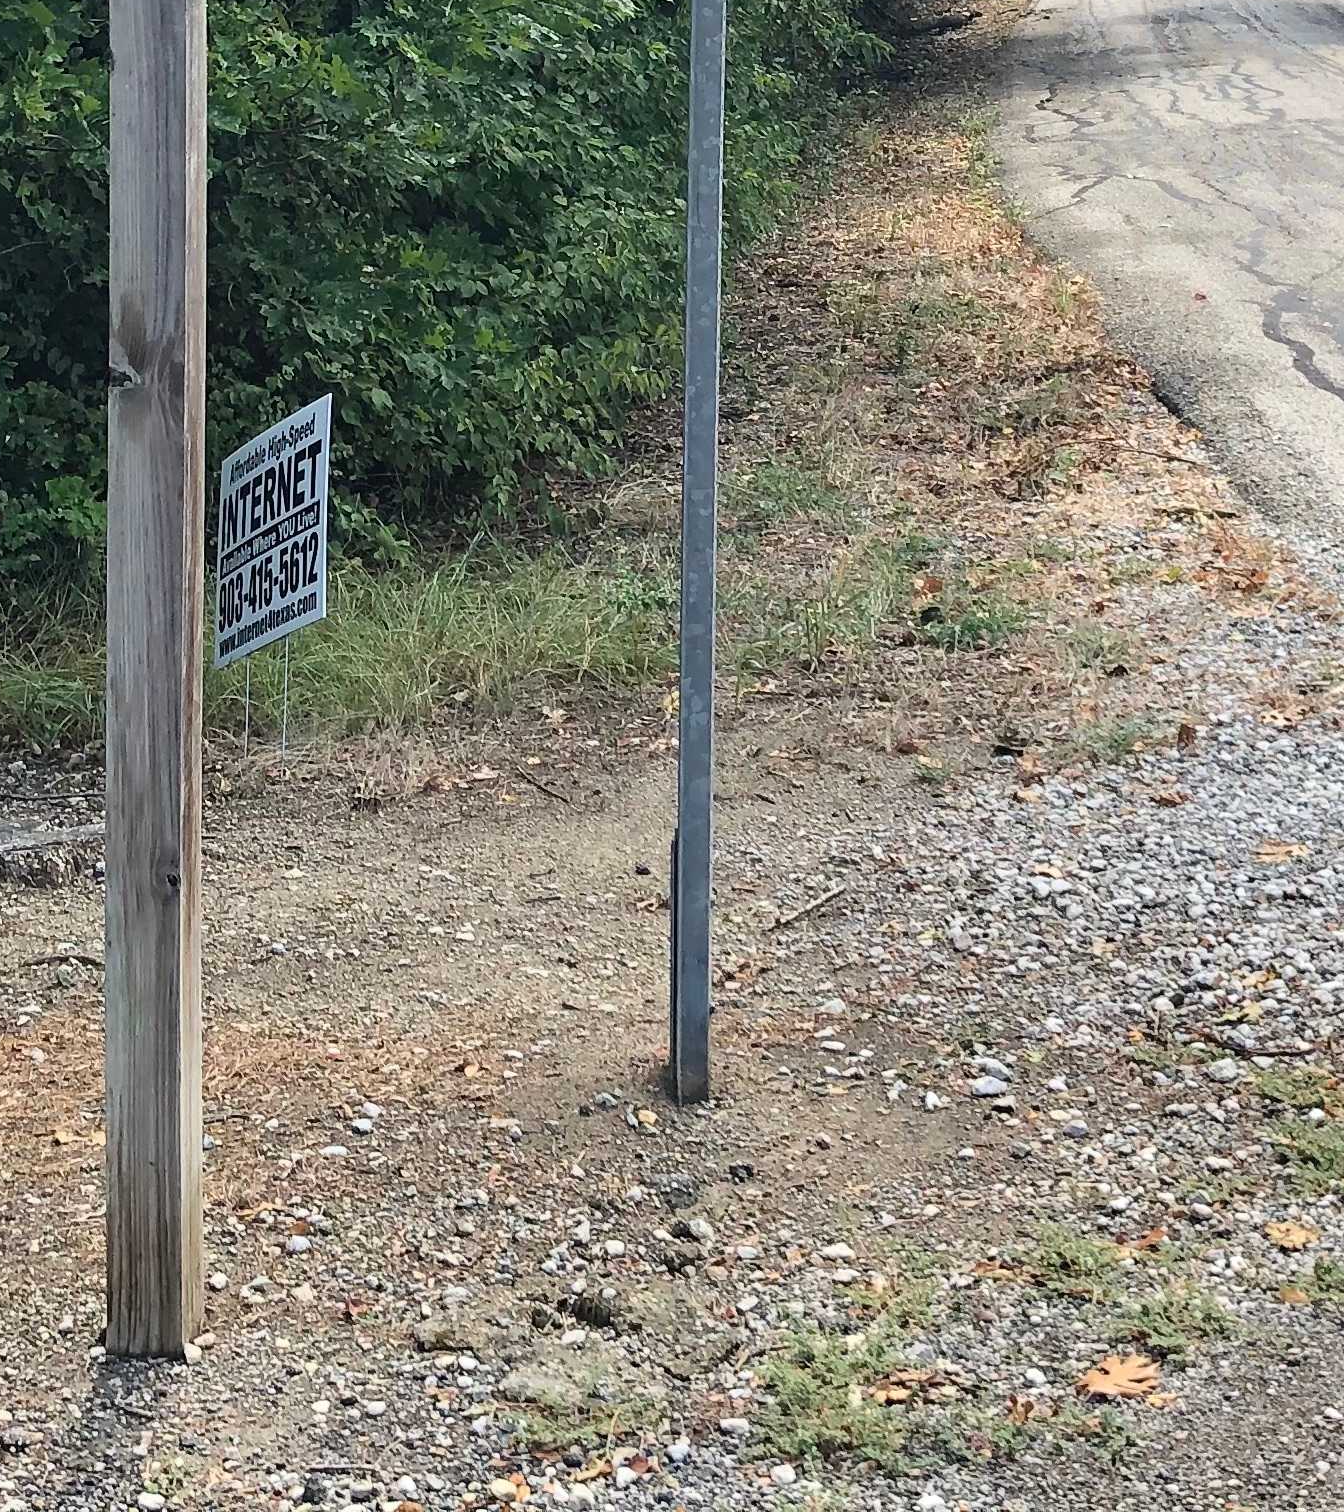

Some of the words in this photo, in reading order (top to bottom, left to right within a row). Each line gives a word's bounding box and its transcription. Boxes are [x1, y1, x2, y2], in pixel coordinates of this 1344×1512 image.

[229, 445, 266, 486] Affordable
[268, 412, 316, 461] High-Speed
[221, 439, 322, 553] INTERNET
[253, 531, 277, 557] Where
[278, 516, 296, 541] YOU
[297, 504, 318, 531] Live!
[219, 531, 319, 634] 903-415-5612
[219, 591, 317, 659] www.internet4texas.com
